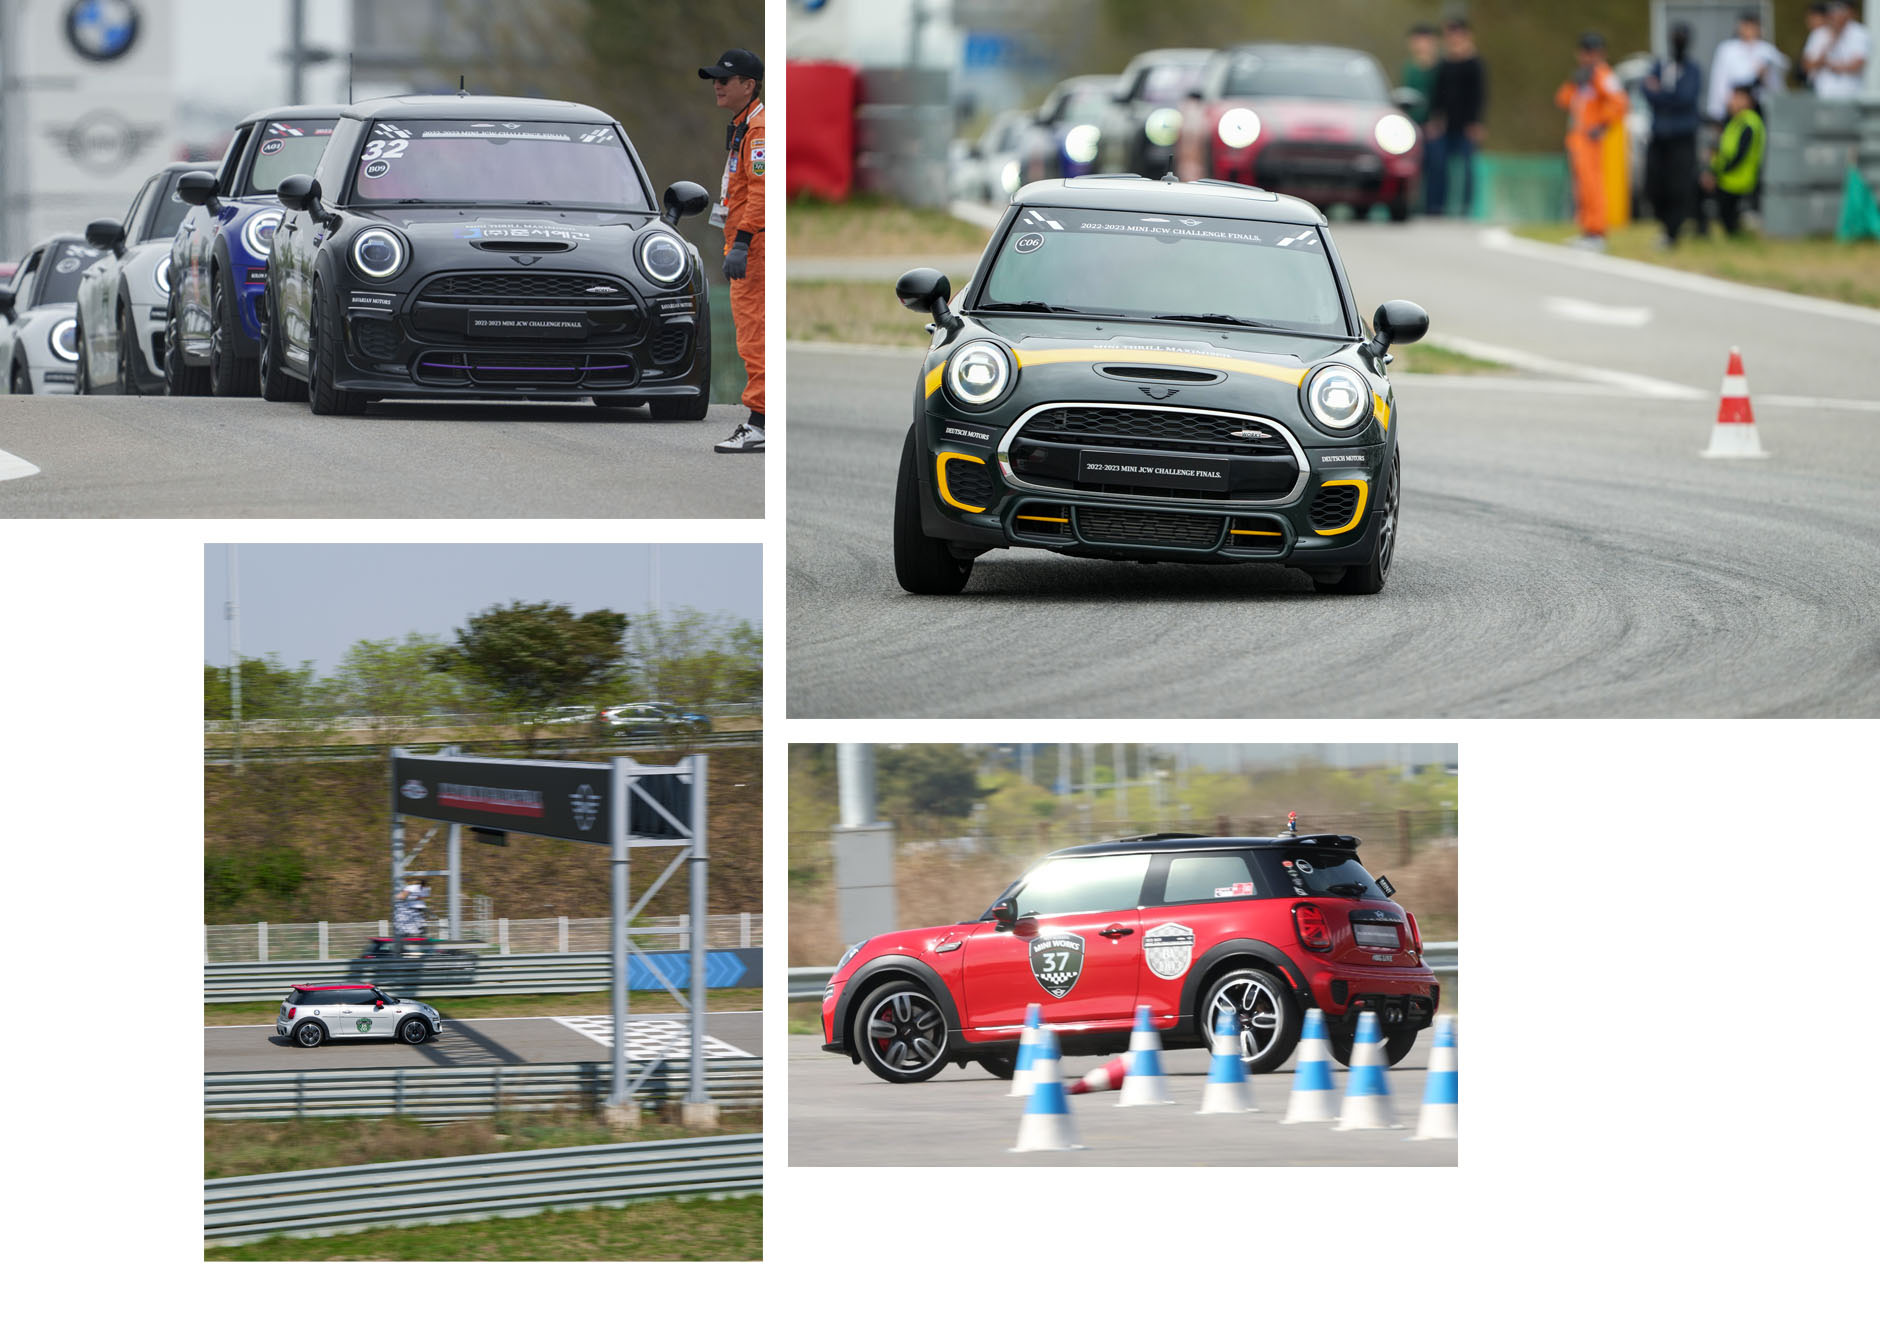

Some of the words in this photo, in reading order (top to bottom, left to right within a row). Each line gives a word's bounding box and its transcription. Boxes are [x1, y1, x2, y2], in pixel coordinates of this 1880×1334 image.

[361, 138, 408, 160] 32
[368, 164, 386, 173] B09
[1080, 222, 1125, 231] 2022-2023
[1172, 228, 1226, 238] CHALLENGE
[1018, 238, 1040, 247] C06
[946, 428, 968, 437] DEUTSCH
[968, 430, 990, 440] MOTORS
[1086, 463, 1120, 472] 2022-2023
[1155, 468, 1195, 476] CHALLENGE
[1034, 940, 1051, 952] MINI
[1052, 940, 1080, 950] WORKS
[1042, 952, 1070, 972] 37
